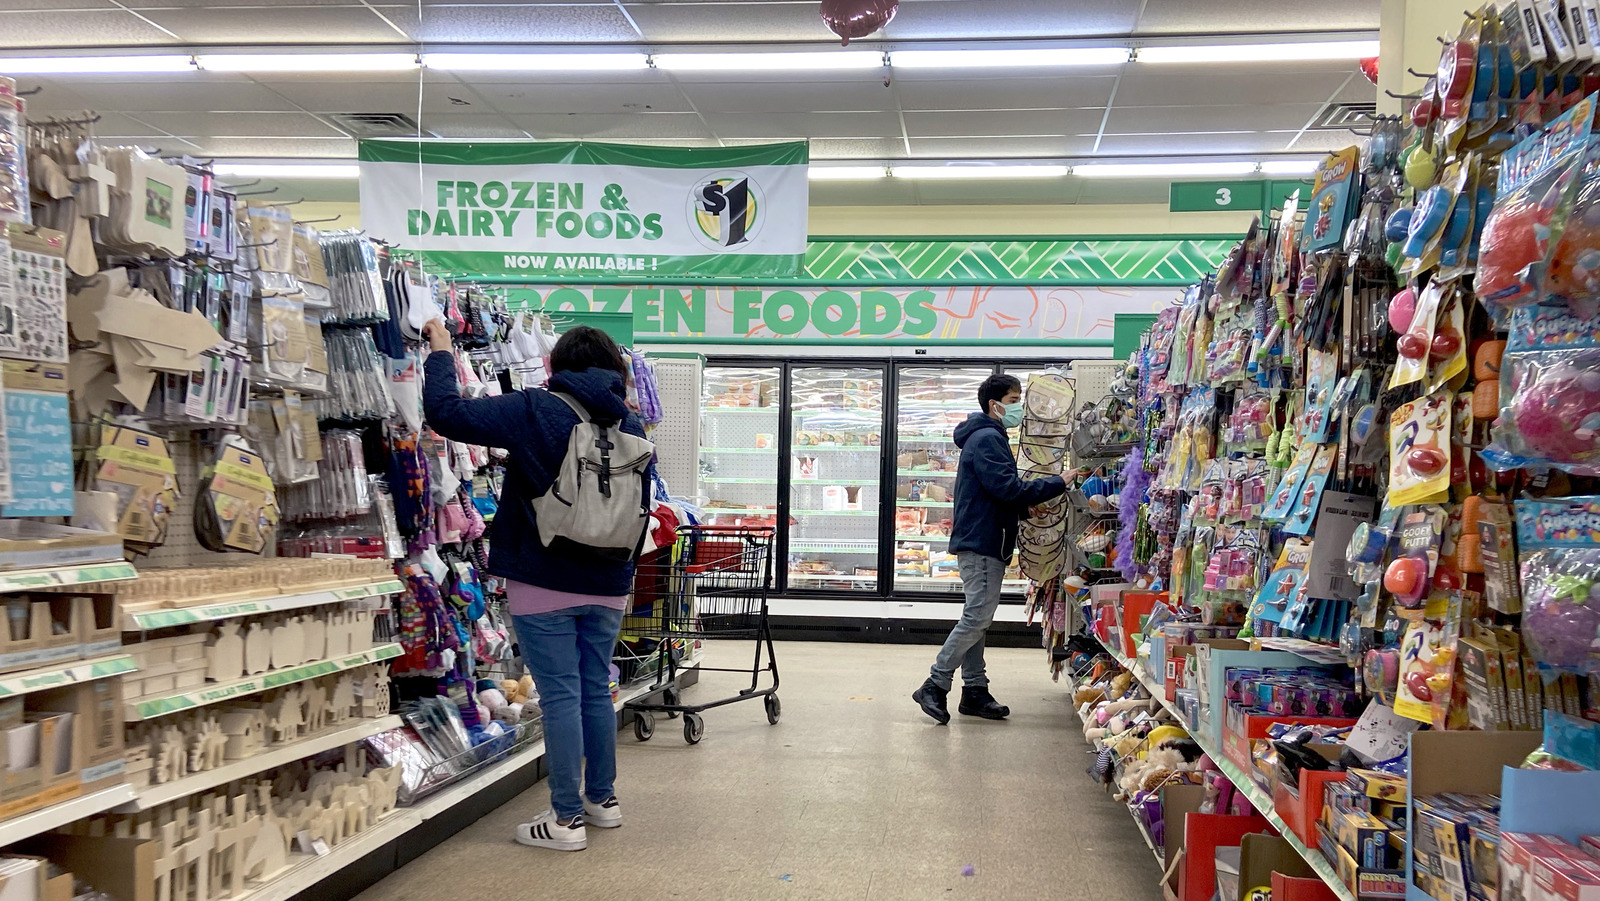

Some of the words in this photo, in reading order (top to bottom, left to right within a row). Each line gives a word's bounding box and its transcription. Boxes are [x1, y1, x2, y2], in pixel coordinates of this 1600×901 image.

[1322, 161, 1347, 181] GROW
[436, 181, 584, 209] FROZEN
[600, 183, 629, 211] &
[1215, 187, 1232, 205] 3
[407, 209, 517, 237] DAIRY
[536, 210, 664, 241] FOODS
[504, 255, 549, 270] NOW
[553, 256, 645, 271] AVAILABLE
[733, 289, 938, 336] FOODS
[1403, 525, 1432, 537] GOOEY
[1404, 537, 1431, 548] PUTTY
